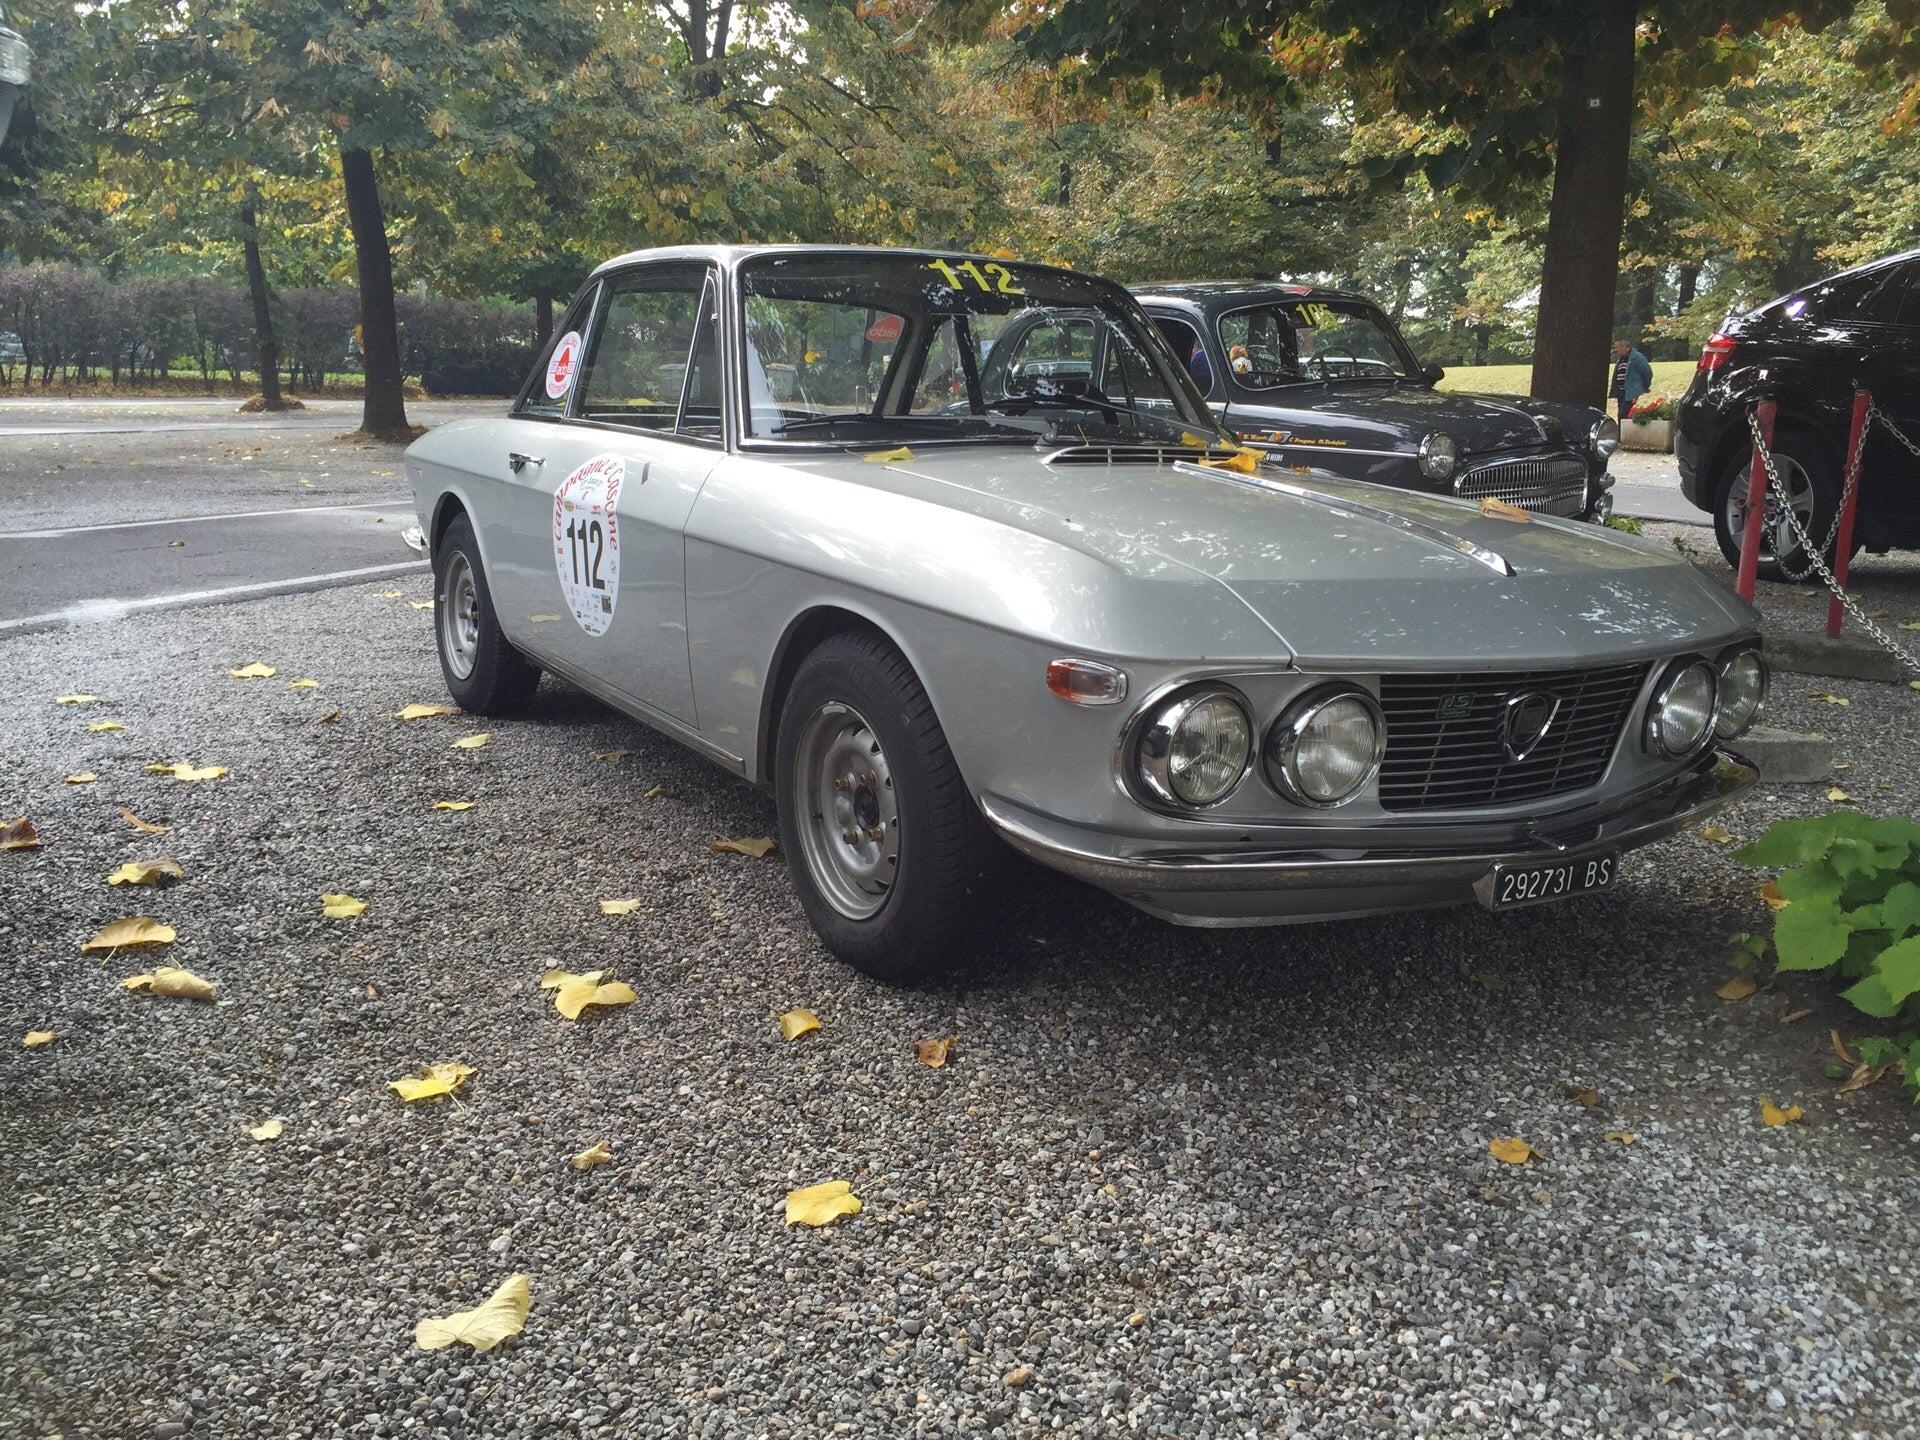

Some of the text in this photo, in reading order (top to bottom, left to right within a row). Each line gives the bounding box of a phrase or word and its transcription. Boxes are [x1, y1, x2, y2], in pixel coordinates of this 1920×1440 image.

[928, 258, 1025, 295] 112
[555, 459, 610, 541] Campagne
[604, 468, 622, 550] Cascine
[566, 517, 606, 590] 112
[1501, 858, 1611, 902] 292731 BS
